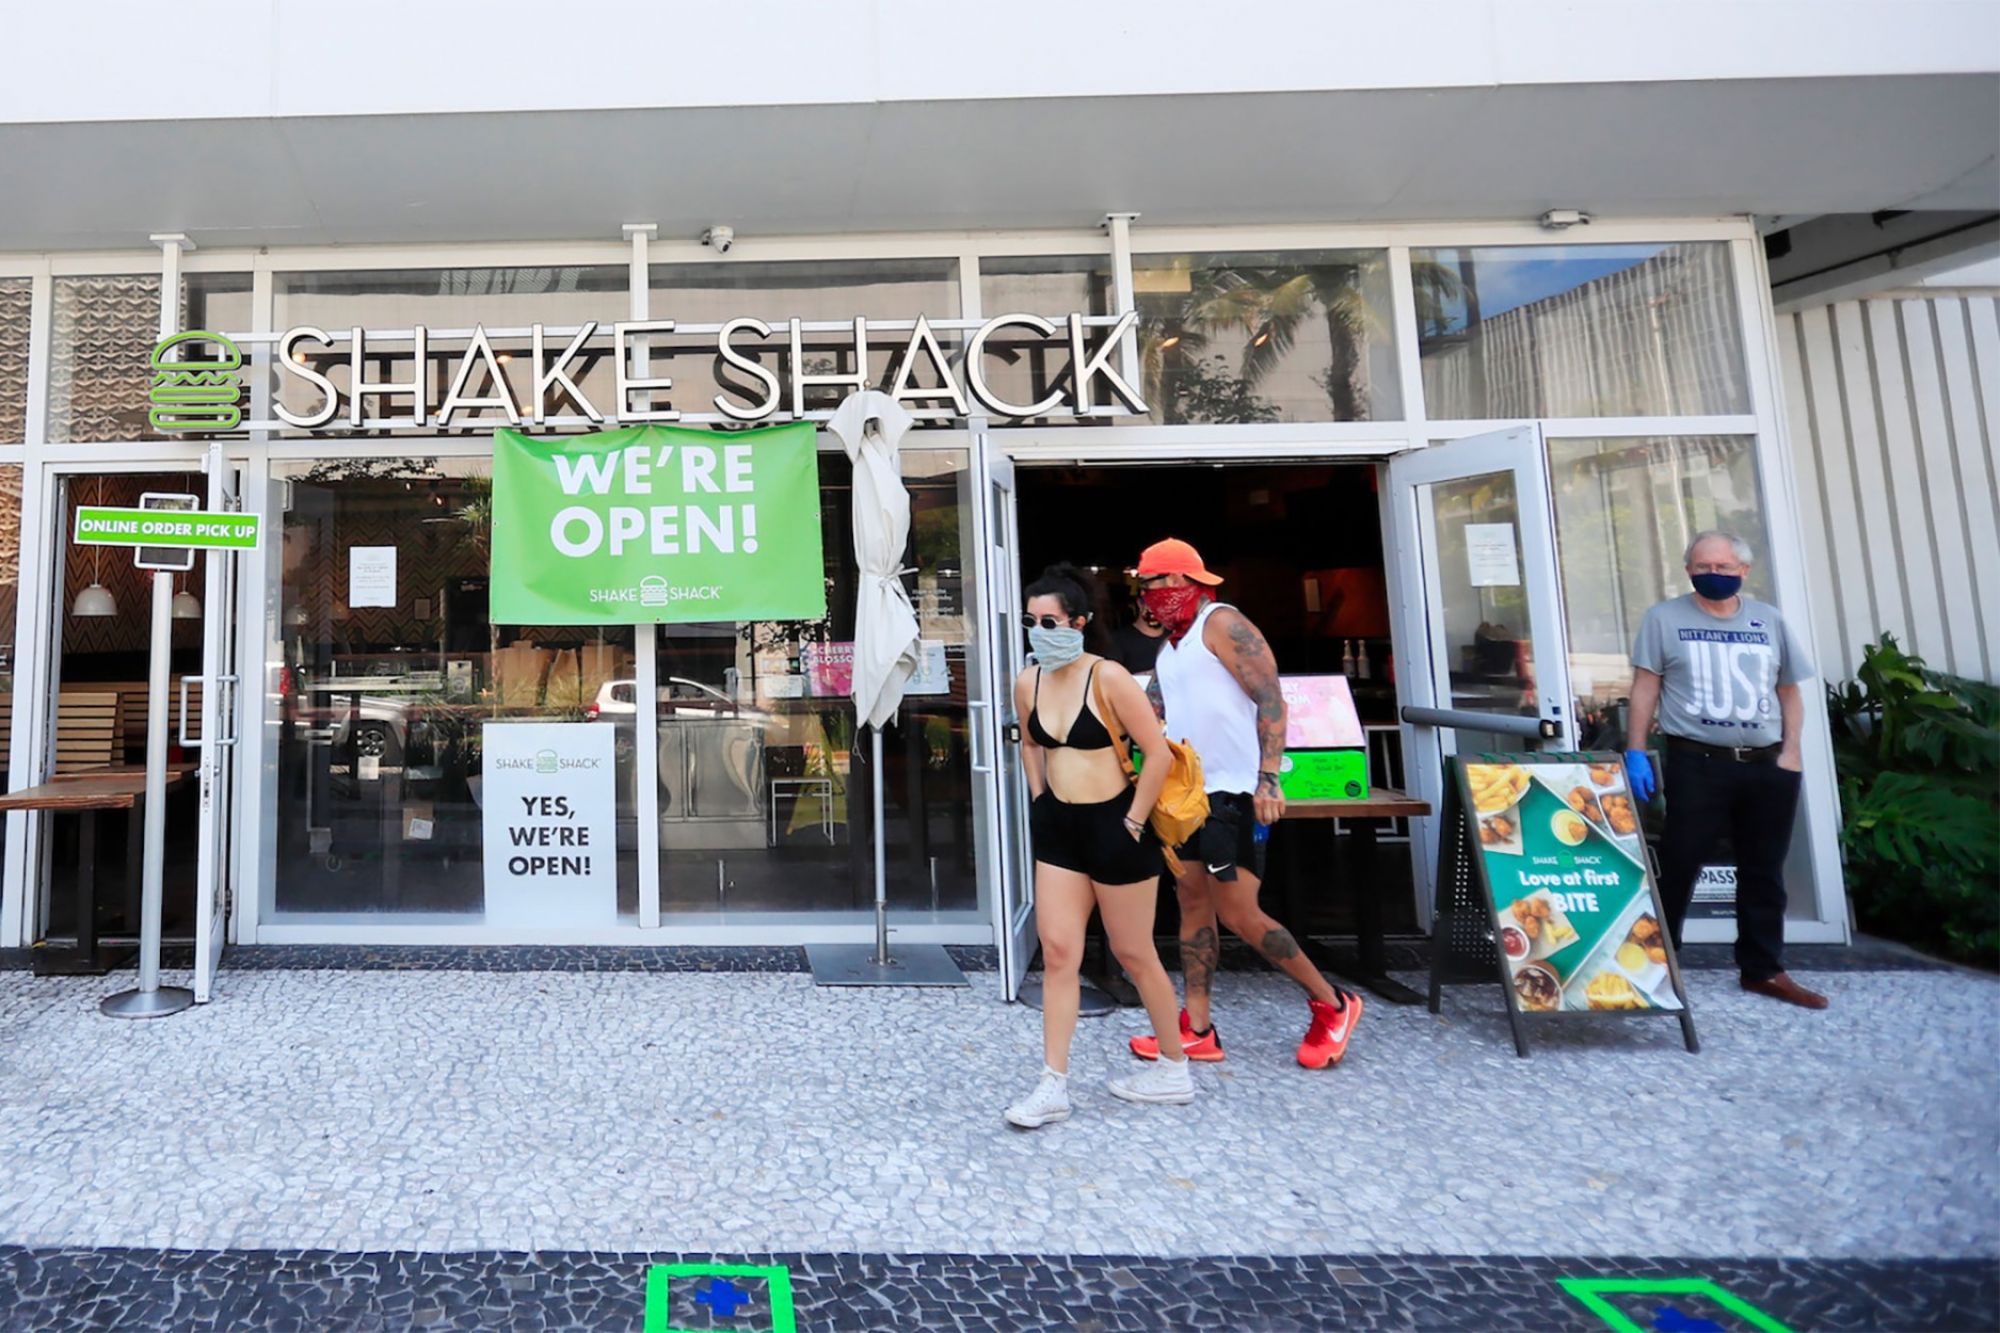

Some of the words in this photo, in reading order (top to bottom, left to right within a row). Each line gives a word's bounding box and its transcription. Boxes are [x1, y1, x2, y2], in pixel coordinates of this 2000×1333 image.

[272, 320, 682, 428] SHAKE
[712, 313, 1149, 420] SHACK
[551, 444, 755, 495] WE'RE
[80, 519, 138, 534] ONLINE
[141, 522, 192, 536] ORDER
[195, 524, 230, 537] PICK
[234, 525, 256, 538] UP
[550, 504, 759, 558] OPEN!
[589, 588, 638, 602] SHAKE
[669, 585, 722, 600] SHACK
[1680, 630, 1731, 641] NITTANY
[1734, 632, 1769, 644] LIONS
[814, 655, 854, 664] BLOSSO
[1685, 640, 1773, 721] JUST
[1701, 718, 1736, 728] DO
[495, 758, 534, 770] SHAKE
[559, 758, 600, 770] SHACK
[521, 796, 576, 820] YES,
[508, 826, 590, 847] WE'RE
[508, 856, 591, 876] OPEN!
[1532, 856, 1559, 865] SHAKE
[1574, 856, 1602, 865] SHACK
[1518, 870, 1561, 886] Love
[1563, 872, 1581, 886] at
[1583, 868, 1620, 886] first
[1552, 892, 1600, 912] BITE
